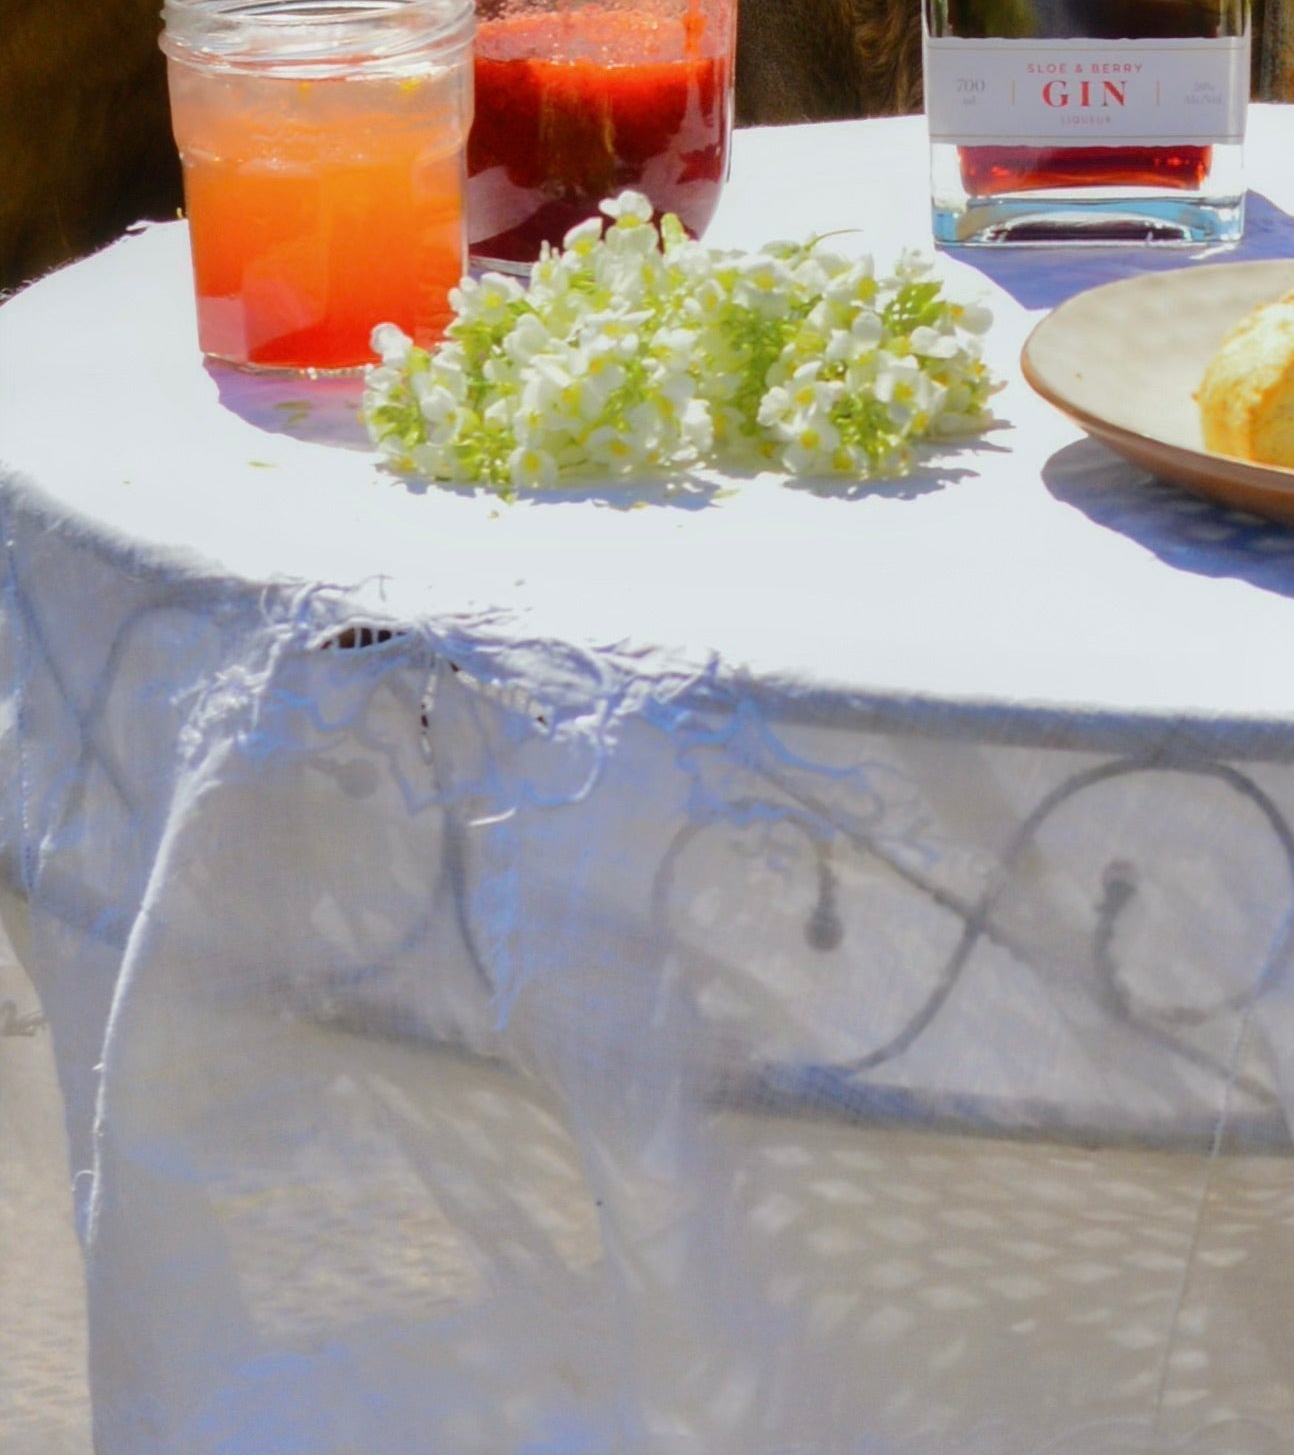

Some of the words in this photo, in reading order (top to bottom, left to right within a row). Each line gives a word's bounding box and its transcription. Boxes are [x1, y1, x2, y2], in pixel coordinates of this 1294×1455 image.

[1027, 63, 1067, 74] SLOE
[1073, 63, 1083, 74] &
[1091, 63, 1143, 74] BERRY
[956, 78, 986, 93] 700
[1041, 80, 1129, 108] GIN
